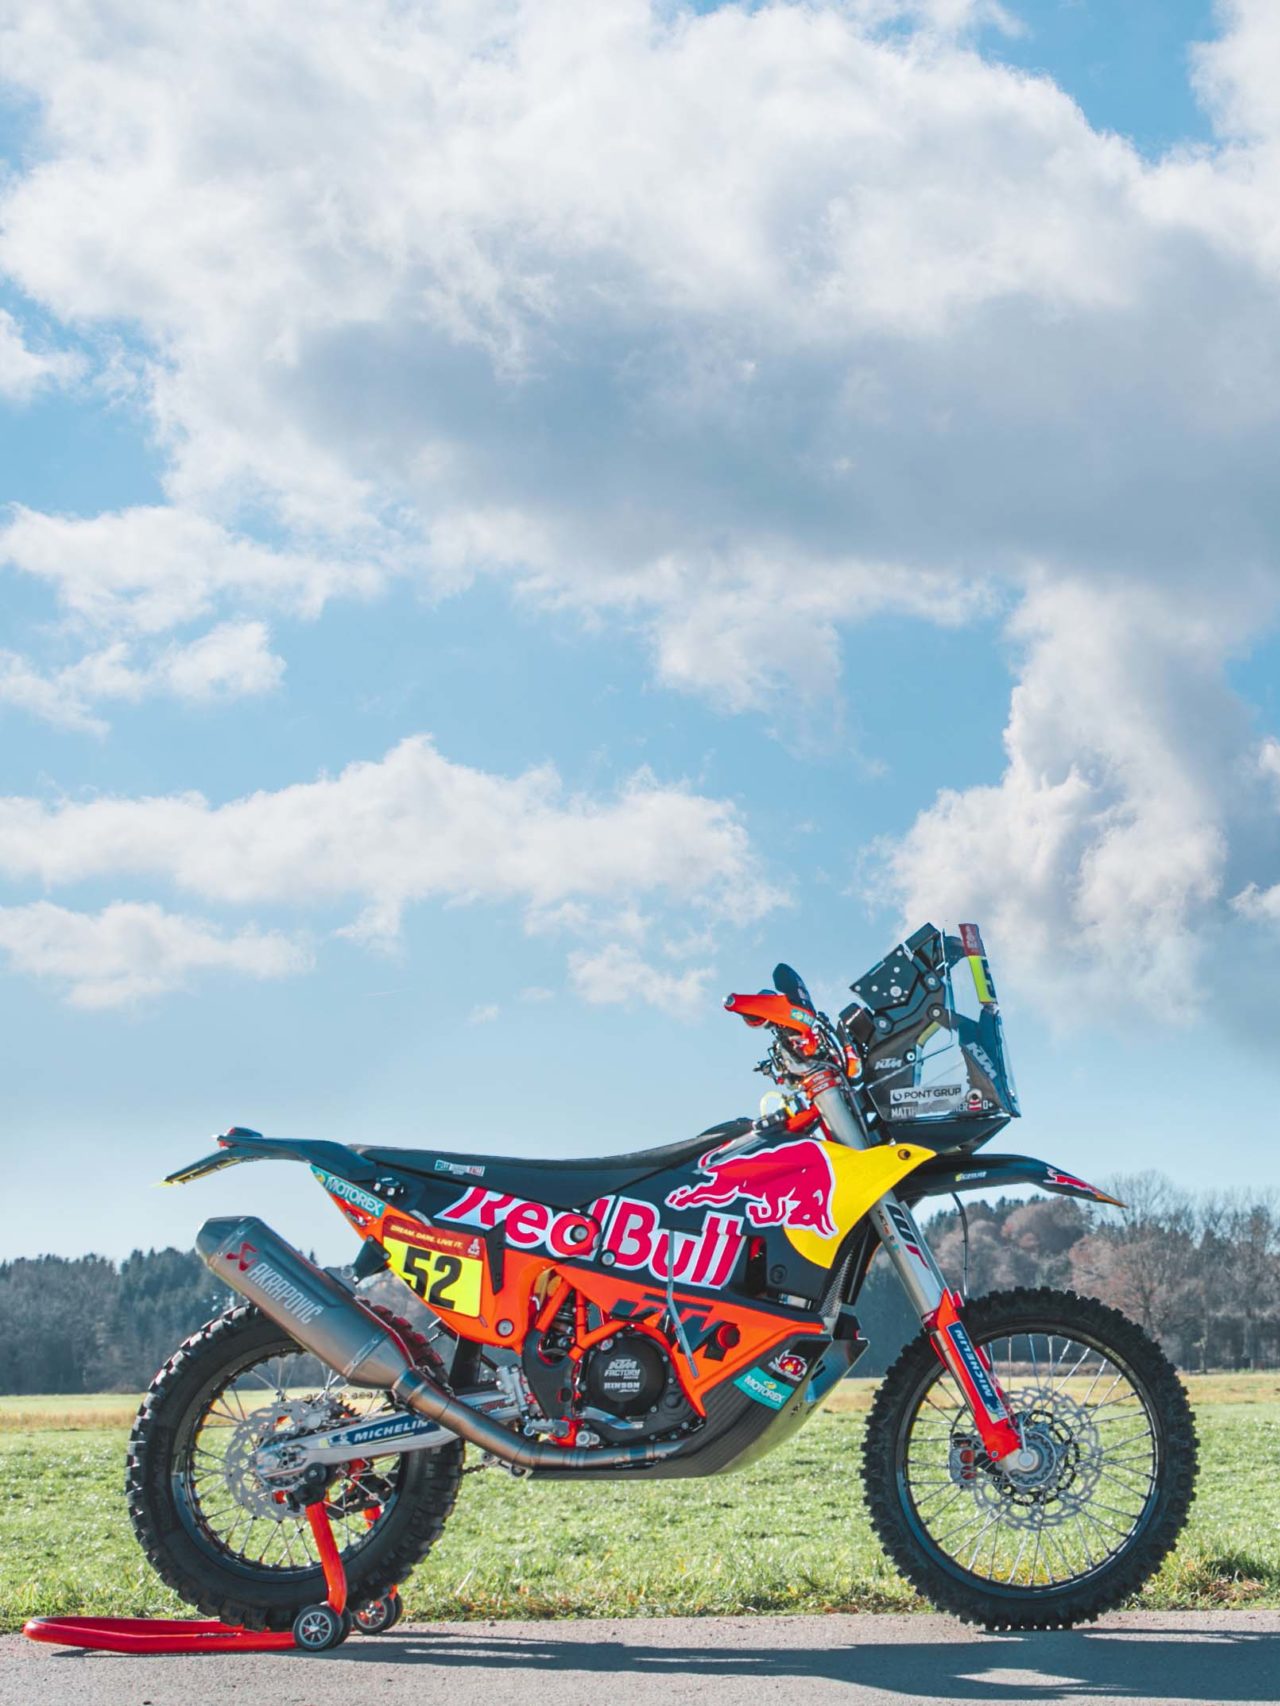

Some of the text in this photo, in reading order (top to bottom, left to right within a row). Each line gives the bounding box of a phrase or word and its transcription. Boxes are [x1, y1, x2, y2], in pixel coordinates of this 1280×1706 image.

[904, 1087, 961, 1099] PONT GRUP
[325, 1176, 383, 1216] MOTOREX
[403, 1246, 462, 1309] 52
[954, 1329, 993, 1397] MICHELIN
[744, 1374, 786, 1404] MOTOREX
[353, 1419, 429, 1442] MICHELIN
